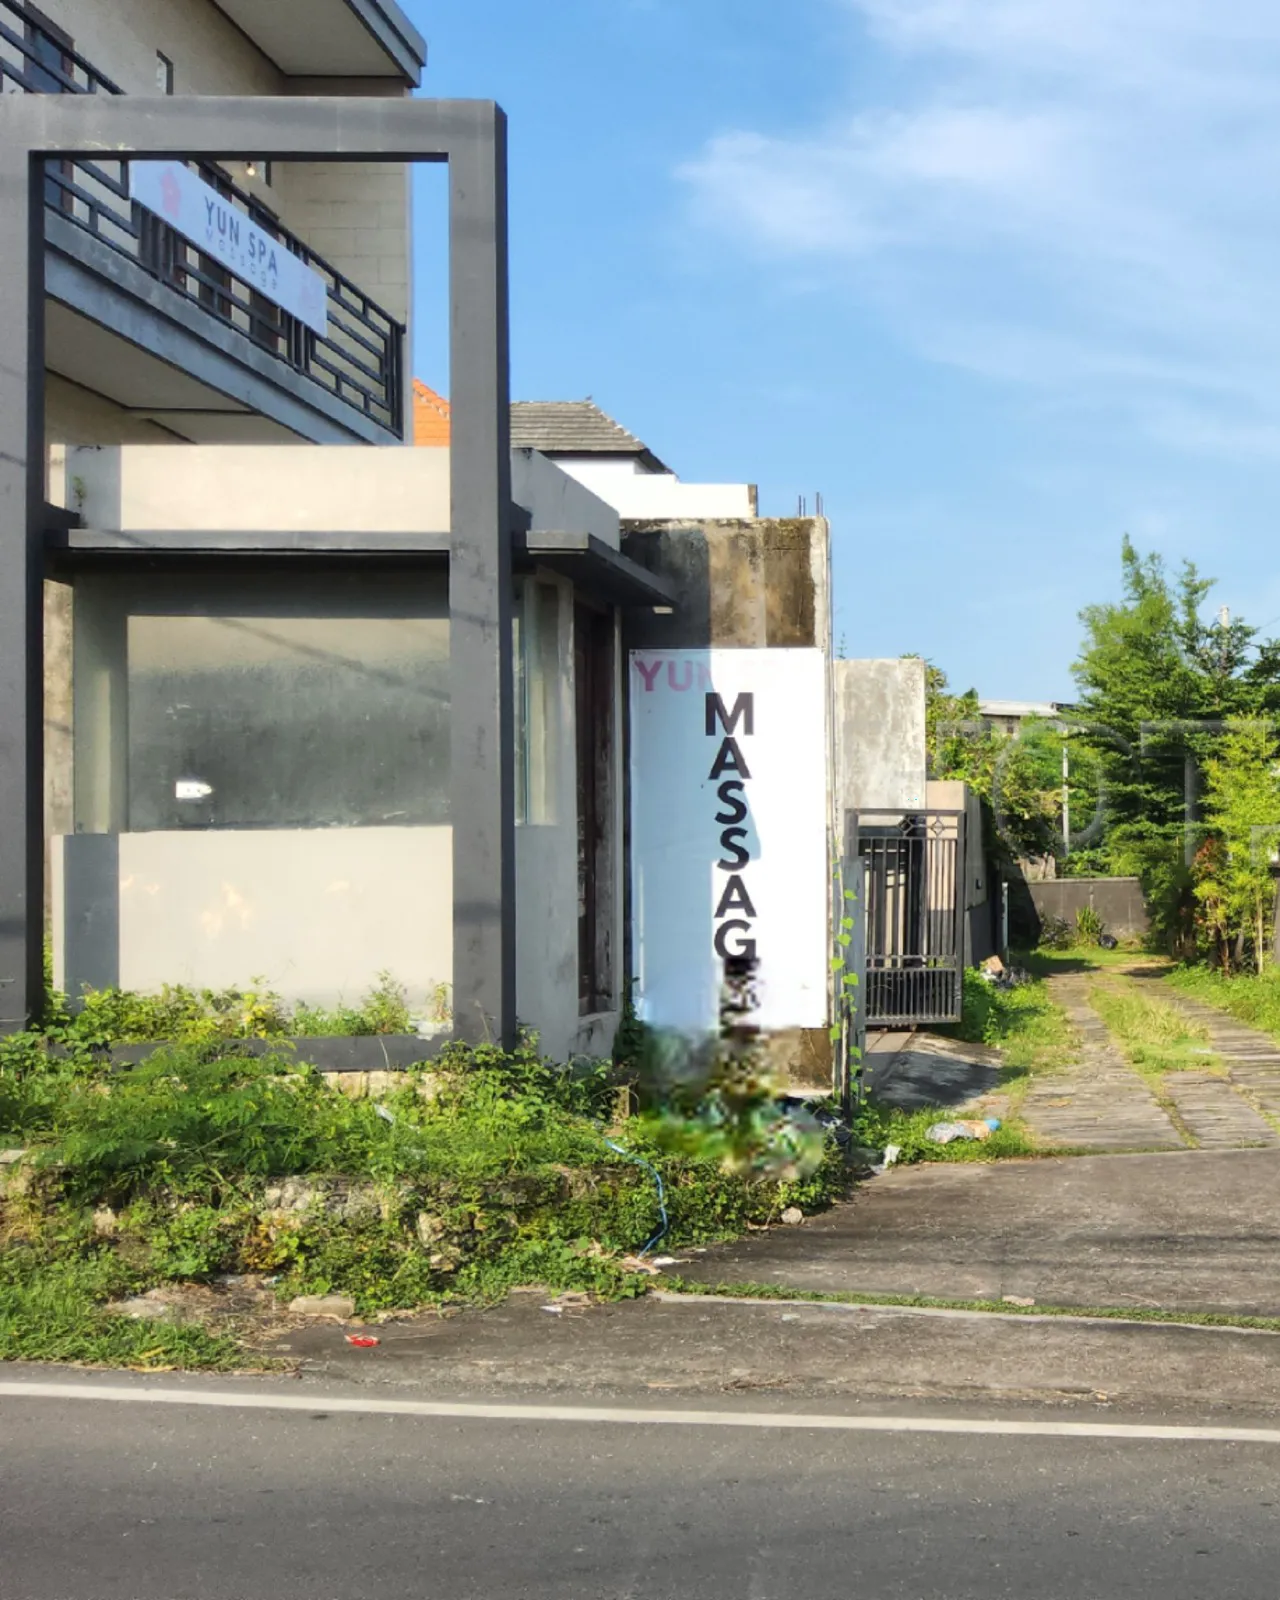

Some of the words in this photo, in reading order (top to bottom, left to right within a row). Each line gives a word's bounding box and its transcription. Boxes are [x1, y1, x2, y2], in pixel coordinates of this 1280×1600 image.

[204, 195, 240, 247] YUN
[248, 231, 278, 277] SPA
[704, 691, 758, 1000] MASSAG
